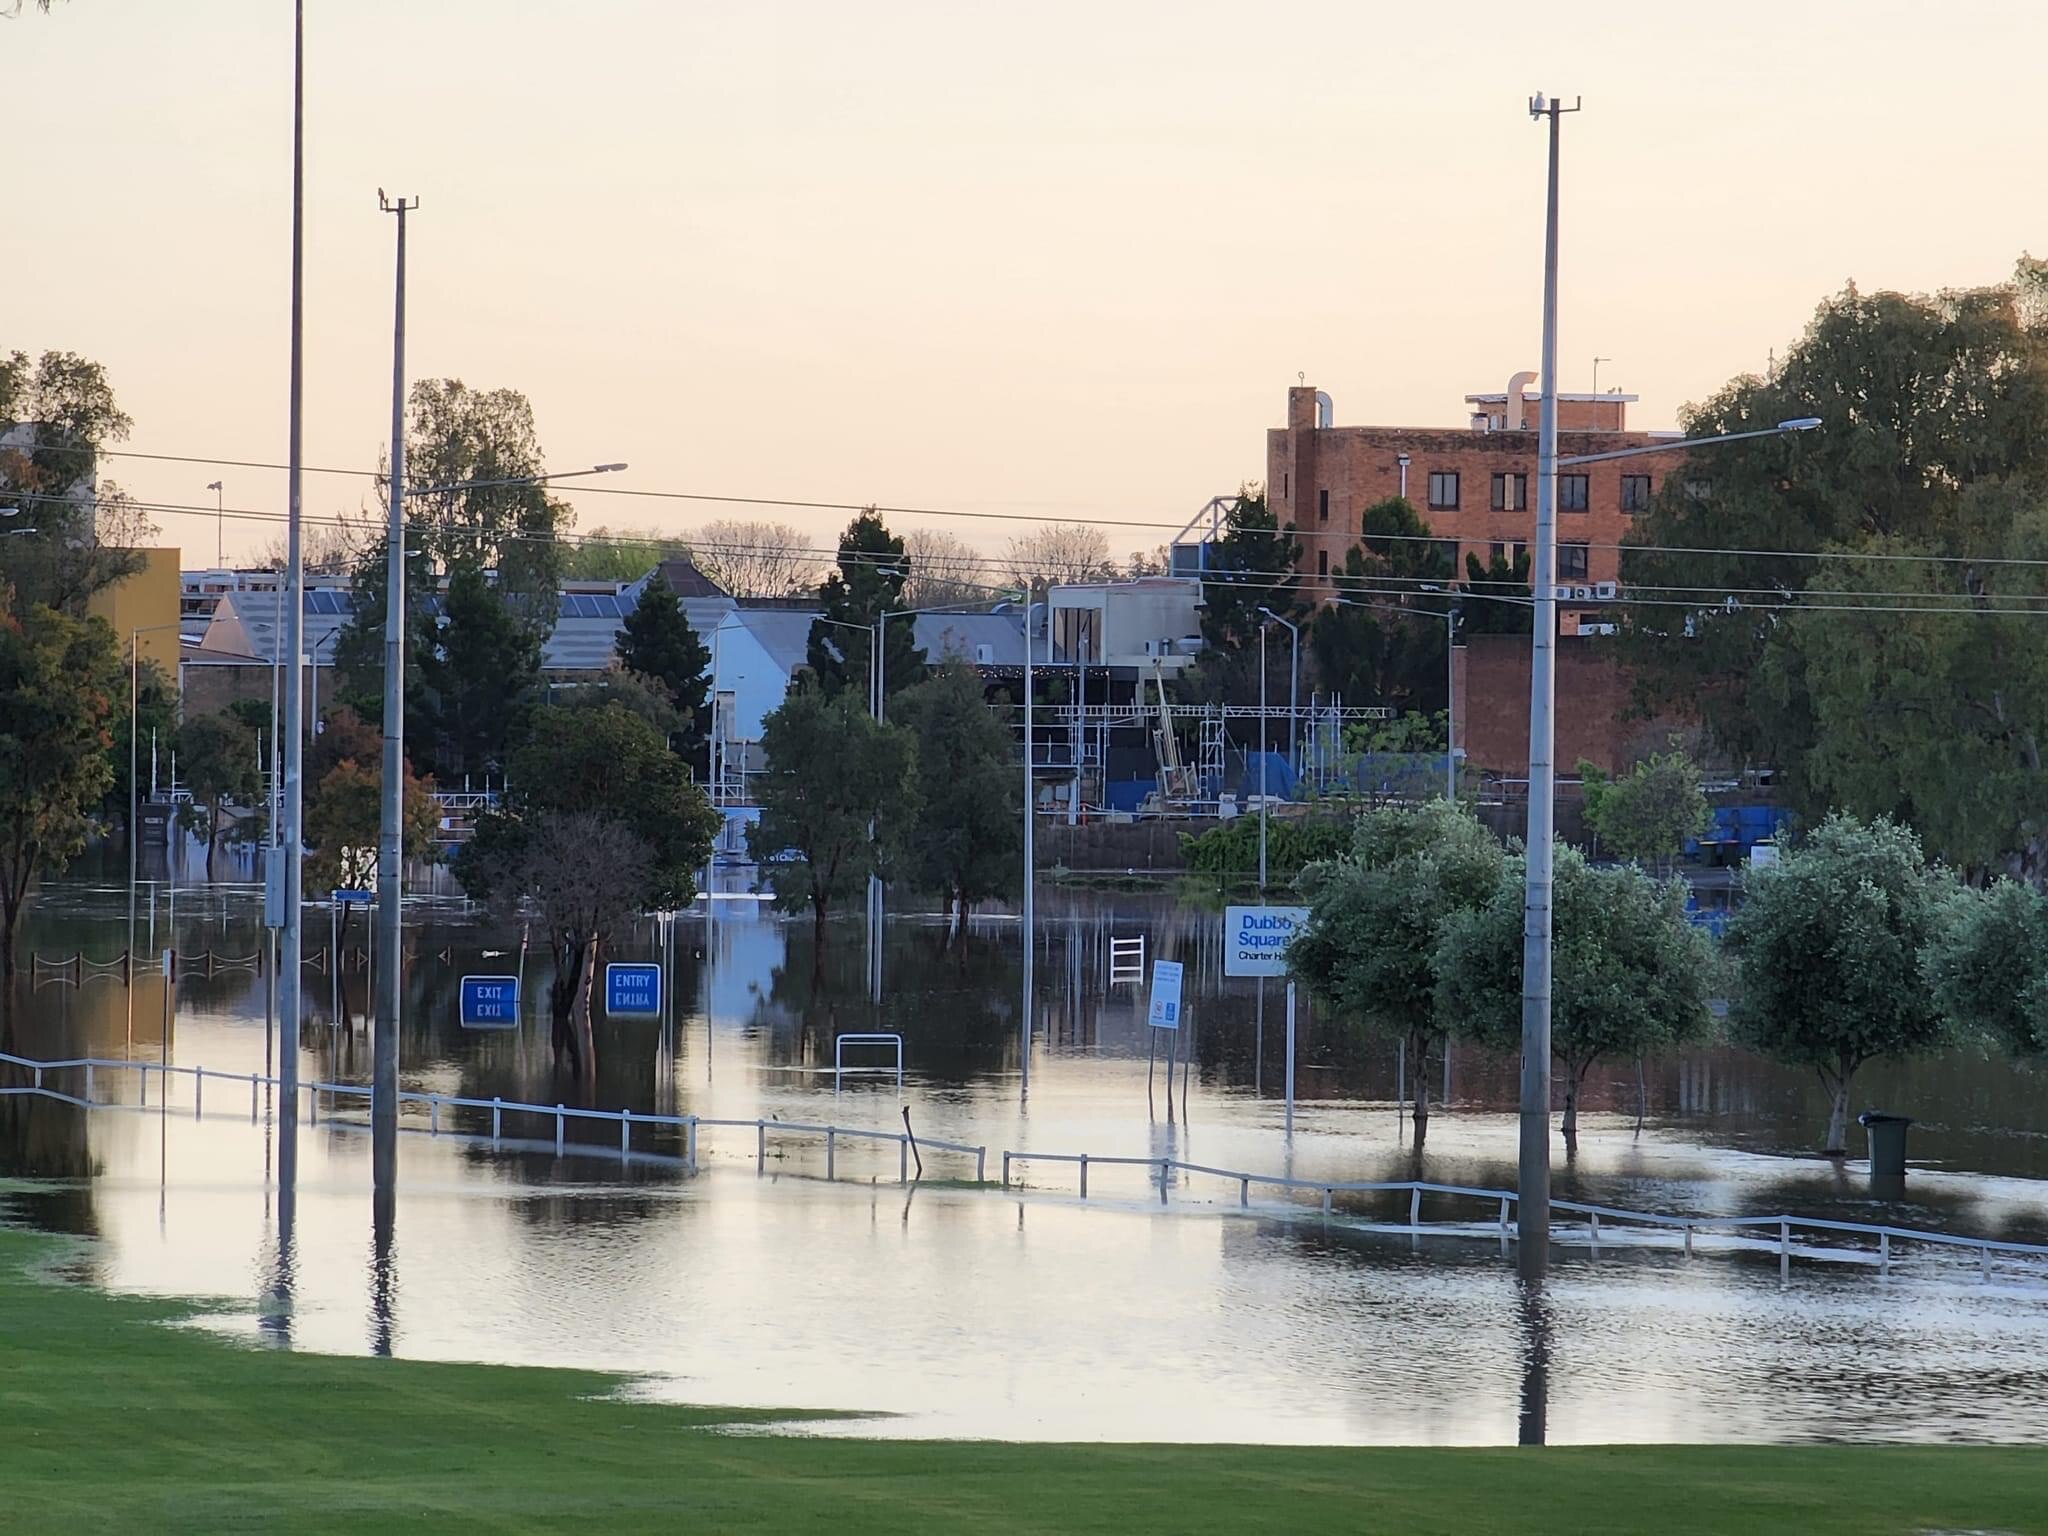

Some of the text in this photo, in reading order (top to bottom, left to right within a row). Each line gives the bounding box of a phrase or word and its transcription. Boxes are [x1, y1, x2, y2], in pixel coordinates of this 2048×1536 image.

[1242, 915, 1292, 929] Dubbo
[1238, 931, 1291, 949] Square
[1238, 951, 1273, 960] Charter
[615, 974, 650, 987] ENTRY
[477, 986, 502, 999] EXIT
